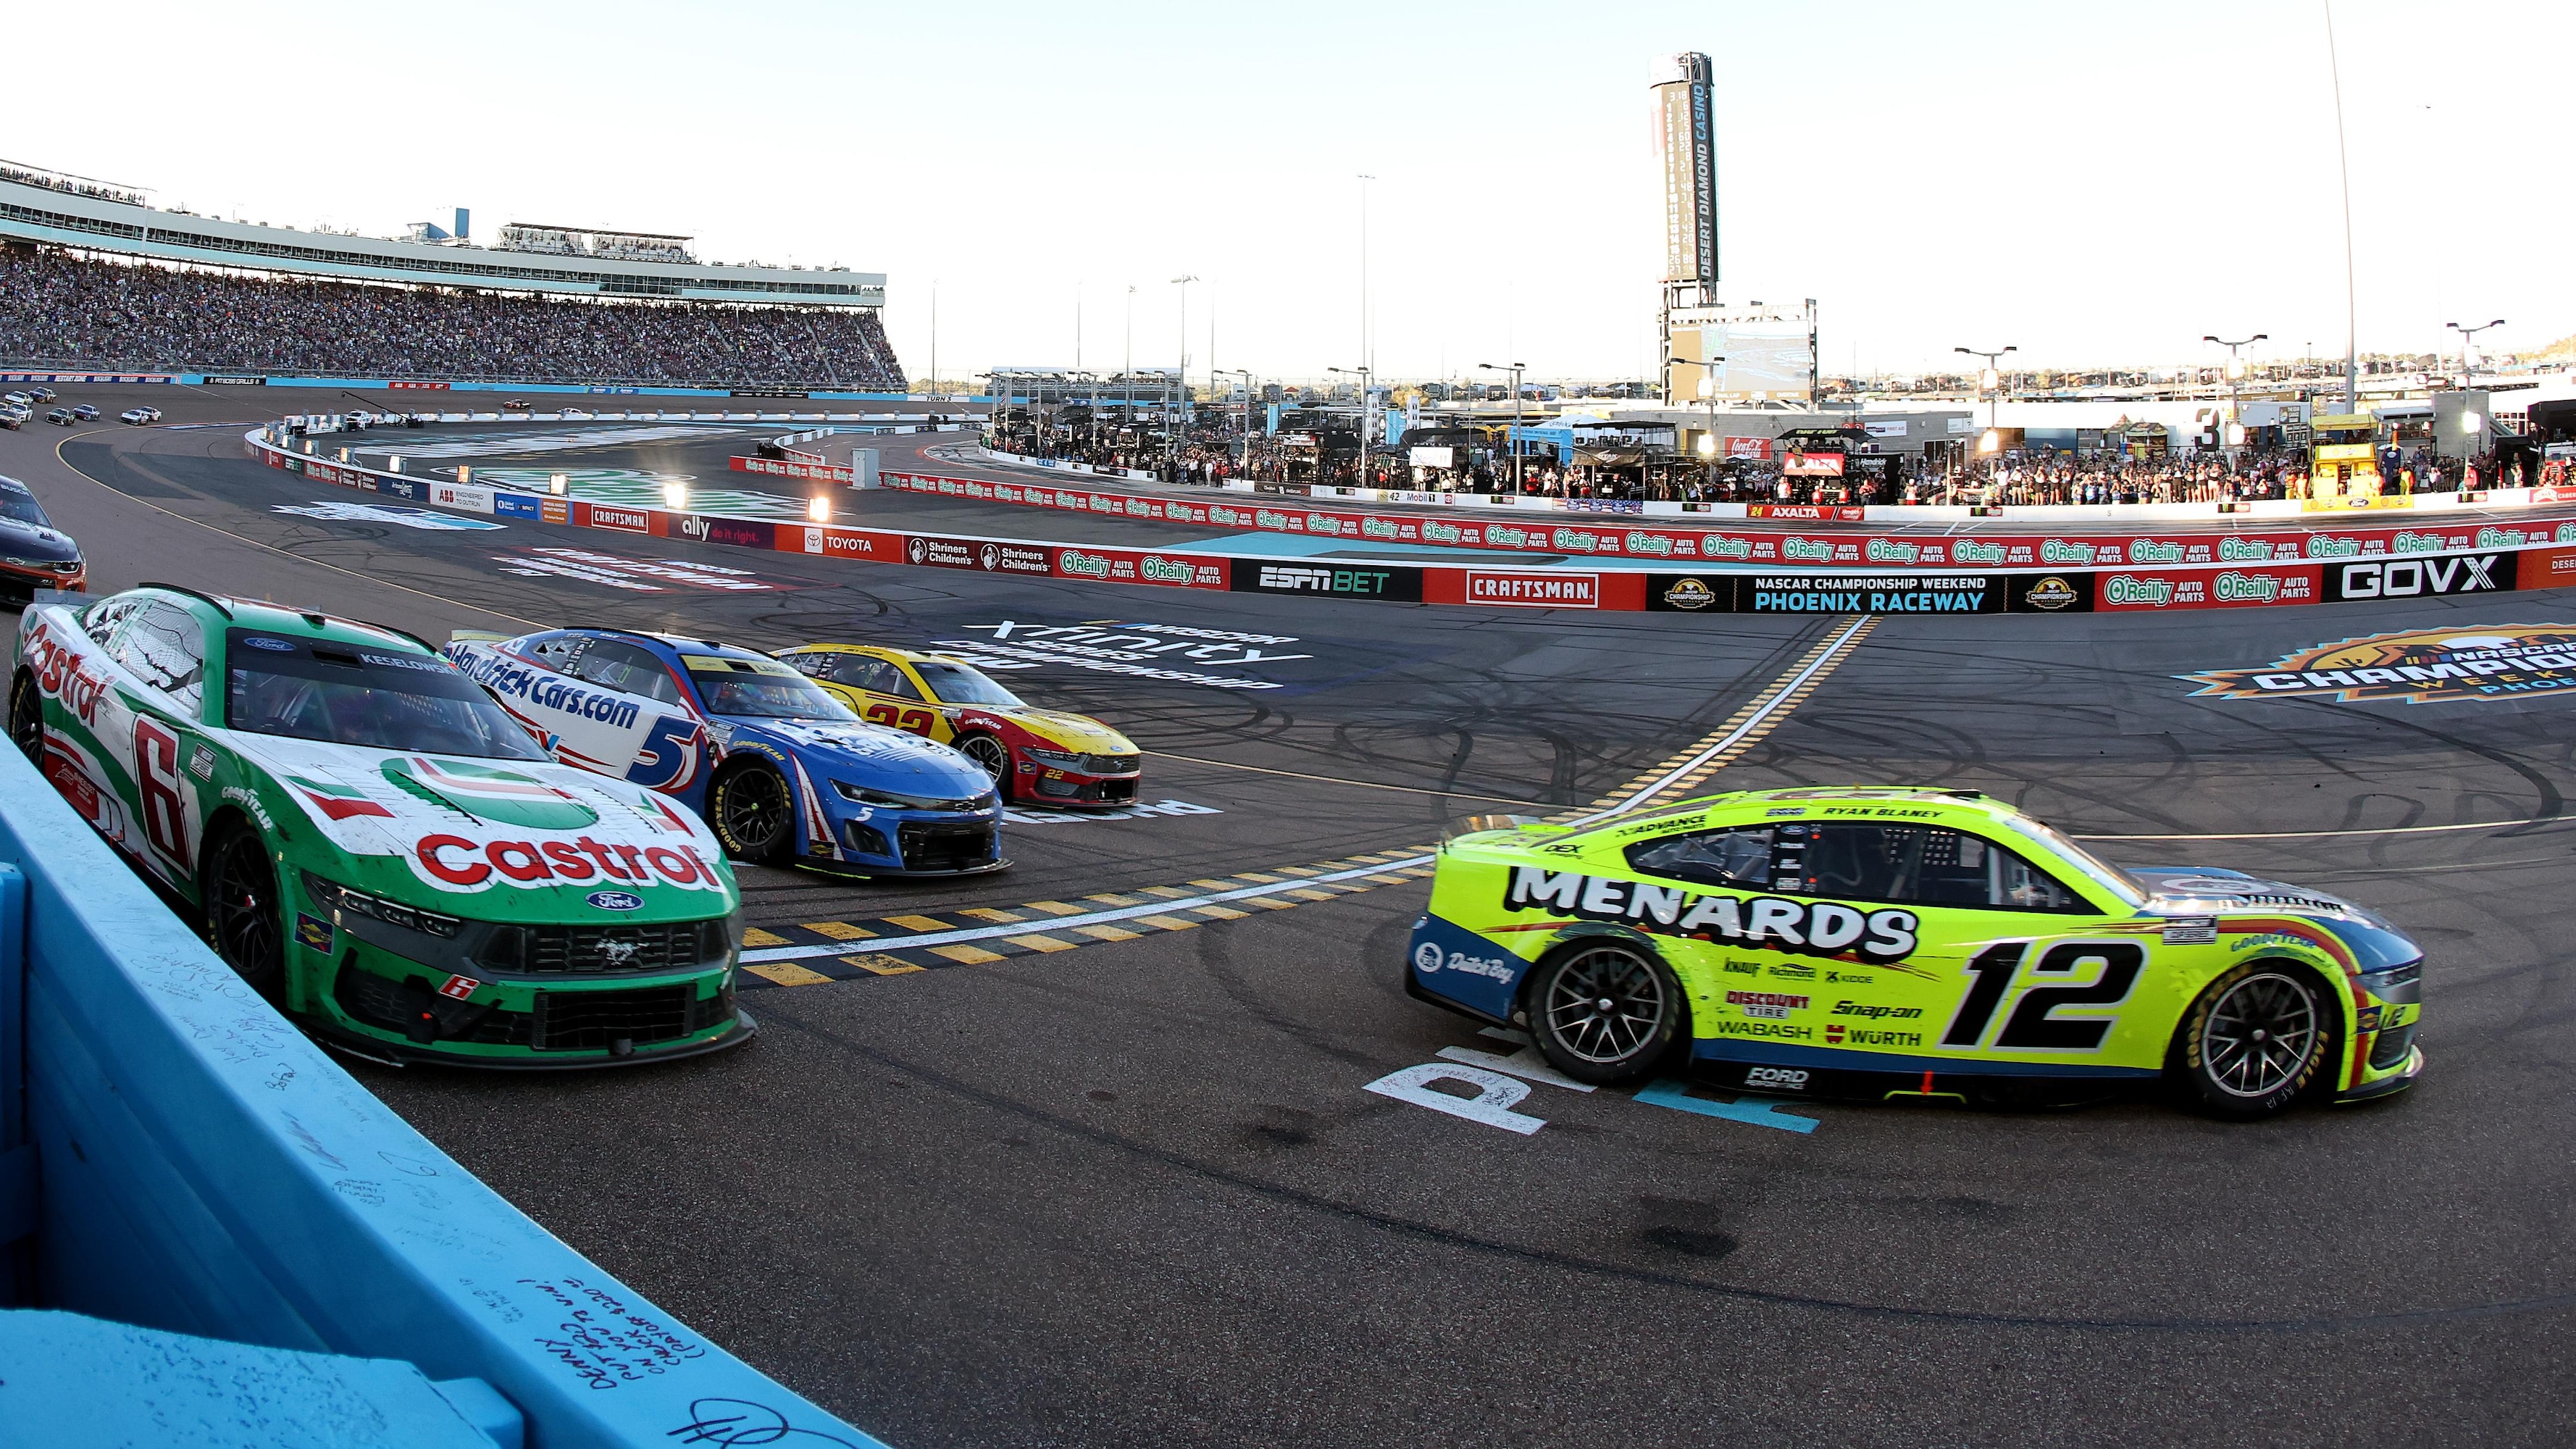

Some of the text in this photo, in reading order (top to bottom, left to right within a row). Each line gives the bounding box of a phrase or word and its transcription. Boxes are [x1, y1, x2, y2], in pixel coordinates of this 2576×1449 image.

[1694, 85, 1711, 277] DESERT DIAMOND CASINO
[2194, 408, 2220, 452] 3
[1786, 458, 1841, 469] AALTA
[1860, 457, 1887, 467] Hendrick
[439, 489, 484, 503] ABB ENGINEERED
[1389, 493, 1400, 501] 42
[1406, 493, 1427, 502] Mobil
[594, 509, 645, 528] CRAFTSMAN
[1255, 509, 1288, 530] O'Reilly
[1750, 507, 1763, 517] 24
[1771, 509, 1820, 519] AXALTA
[682, 516, 759, 544] ally do it right.
[1362, 517, 1399, 539] O'Reilly
[1485, 525, 1527, 548] O'Reilly
[826, 535, 873, 553] TOYOTA
[929, 540, 968, 555] Shriners
[1625, 531, 1673, 556] O'Reilly
[1782, 536, 1860, 563] O'Reilly AUTO PARTS
[1952, 538, 2033, 565] O'Reilly AUTO PARTS
[2129, 538, 2211, 564] O'Reilly AUTO PARTS
[929, 552, 972, 566] Children's
[1002, 548, 1044, 561] Shriners
[1060, 550, 1135, 578] O'Reilly AUTO PARTS
[1001, 559, 1048, 572] Children's
[1140, 556, 1221, 585] O'Reilly AUTO PARTS
[1259, 566, 1390, 593] ESPN BET
[1755, 577, 1986, 590] NASCAR CHAMPIONSHIP WEEKEND
[2213, 570, 2310, 604] O'Reilly AUTO PARTS
[2341, 555, 2498, 599] GOVX
[1474, 578, 1590, 600] CRAFTSMAN
[2104, 574, 2204, 606] O'Reilly AUTO PARTS
[1755, 593, 1984, 611] PHOENIX RACEWAY
[1134, 623, 1299, 643] NASCAR
[249, 638, 292, 651] Ford
[24, 622, 109, 727] Castrol
[359, 653, 460, 677] KESELOWSKI
[2251, 651, 2576, 690] CHAMPIO
[453, 643, 641, 730] HendrickCars.com
[964, 717, 1003, 730] GOODYEAR
[623, 713, 703, 791] 5
[732, 740, 786, 761] GOODYEAR
[1044, 769, 1065, 780] 22
[133, 714, 194, 881] 6
[221, 785, 274, 834] GOODYEAR
[716, 785, 742, 853] GOODYEAR
[855, 806, 874, 821] 5
[1823, 806, 1944, 819] RYAN BLANEY
[1636, 814, 1707, 834] ADVANCE
[1543, 844, 1585, 853] DEX
[415, 833, 720, 888] Castrol
[594, 893, 638, 910] Ford
[1507, 866, 1920, 960] MENARDS
[2230, 930, 2317, 952] GOODYEAR
[1723, 956, 1762, 978] KNAUF
[1768, 965, 1817, 979] Richmond
[446, 976, 475, 998] 6
[1841, 975, 1874, 984] KIDDE
[1726, 990, 1811, 1009] DISCOUNT
[1936, 938, 2149, 1053] 12
[1745, 1006, 1790, 1019] TIRE
[1830, 1000, 1923, 1020] Snap-on
[1717, 1021, 1812, 1040] WABASH
[1849, 1029, 1923, 1046] WÜRTH
[1747, 1066, 1810, 1082] FORD
